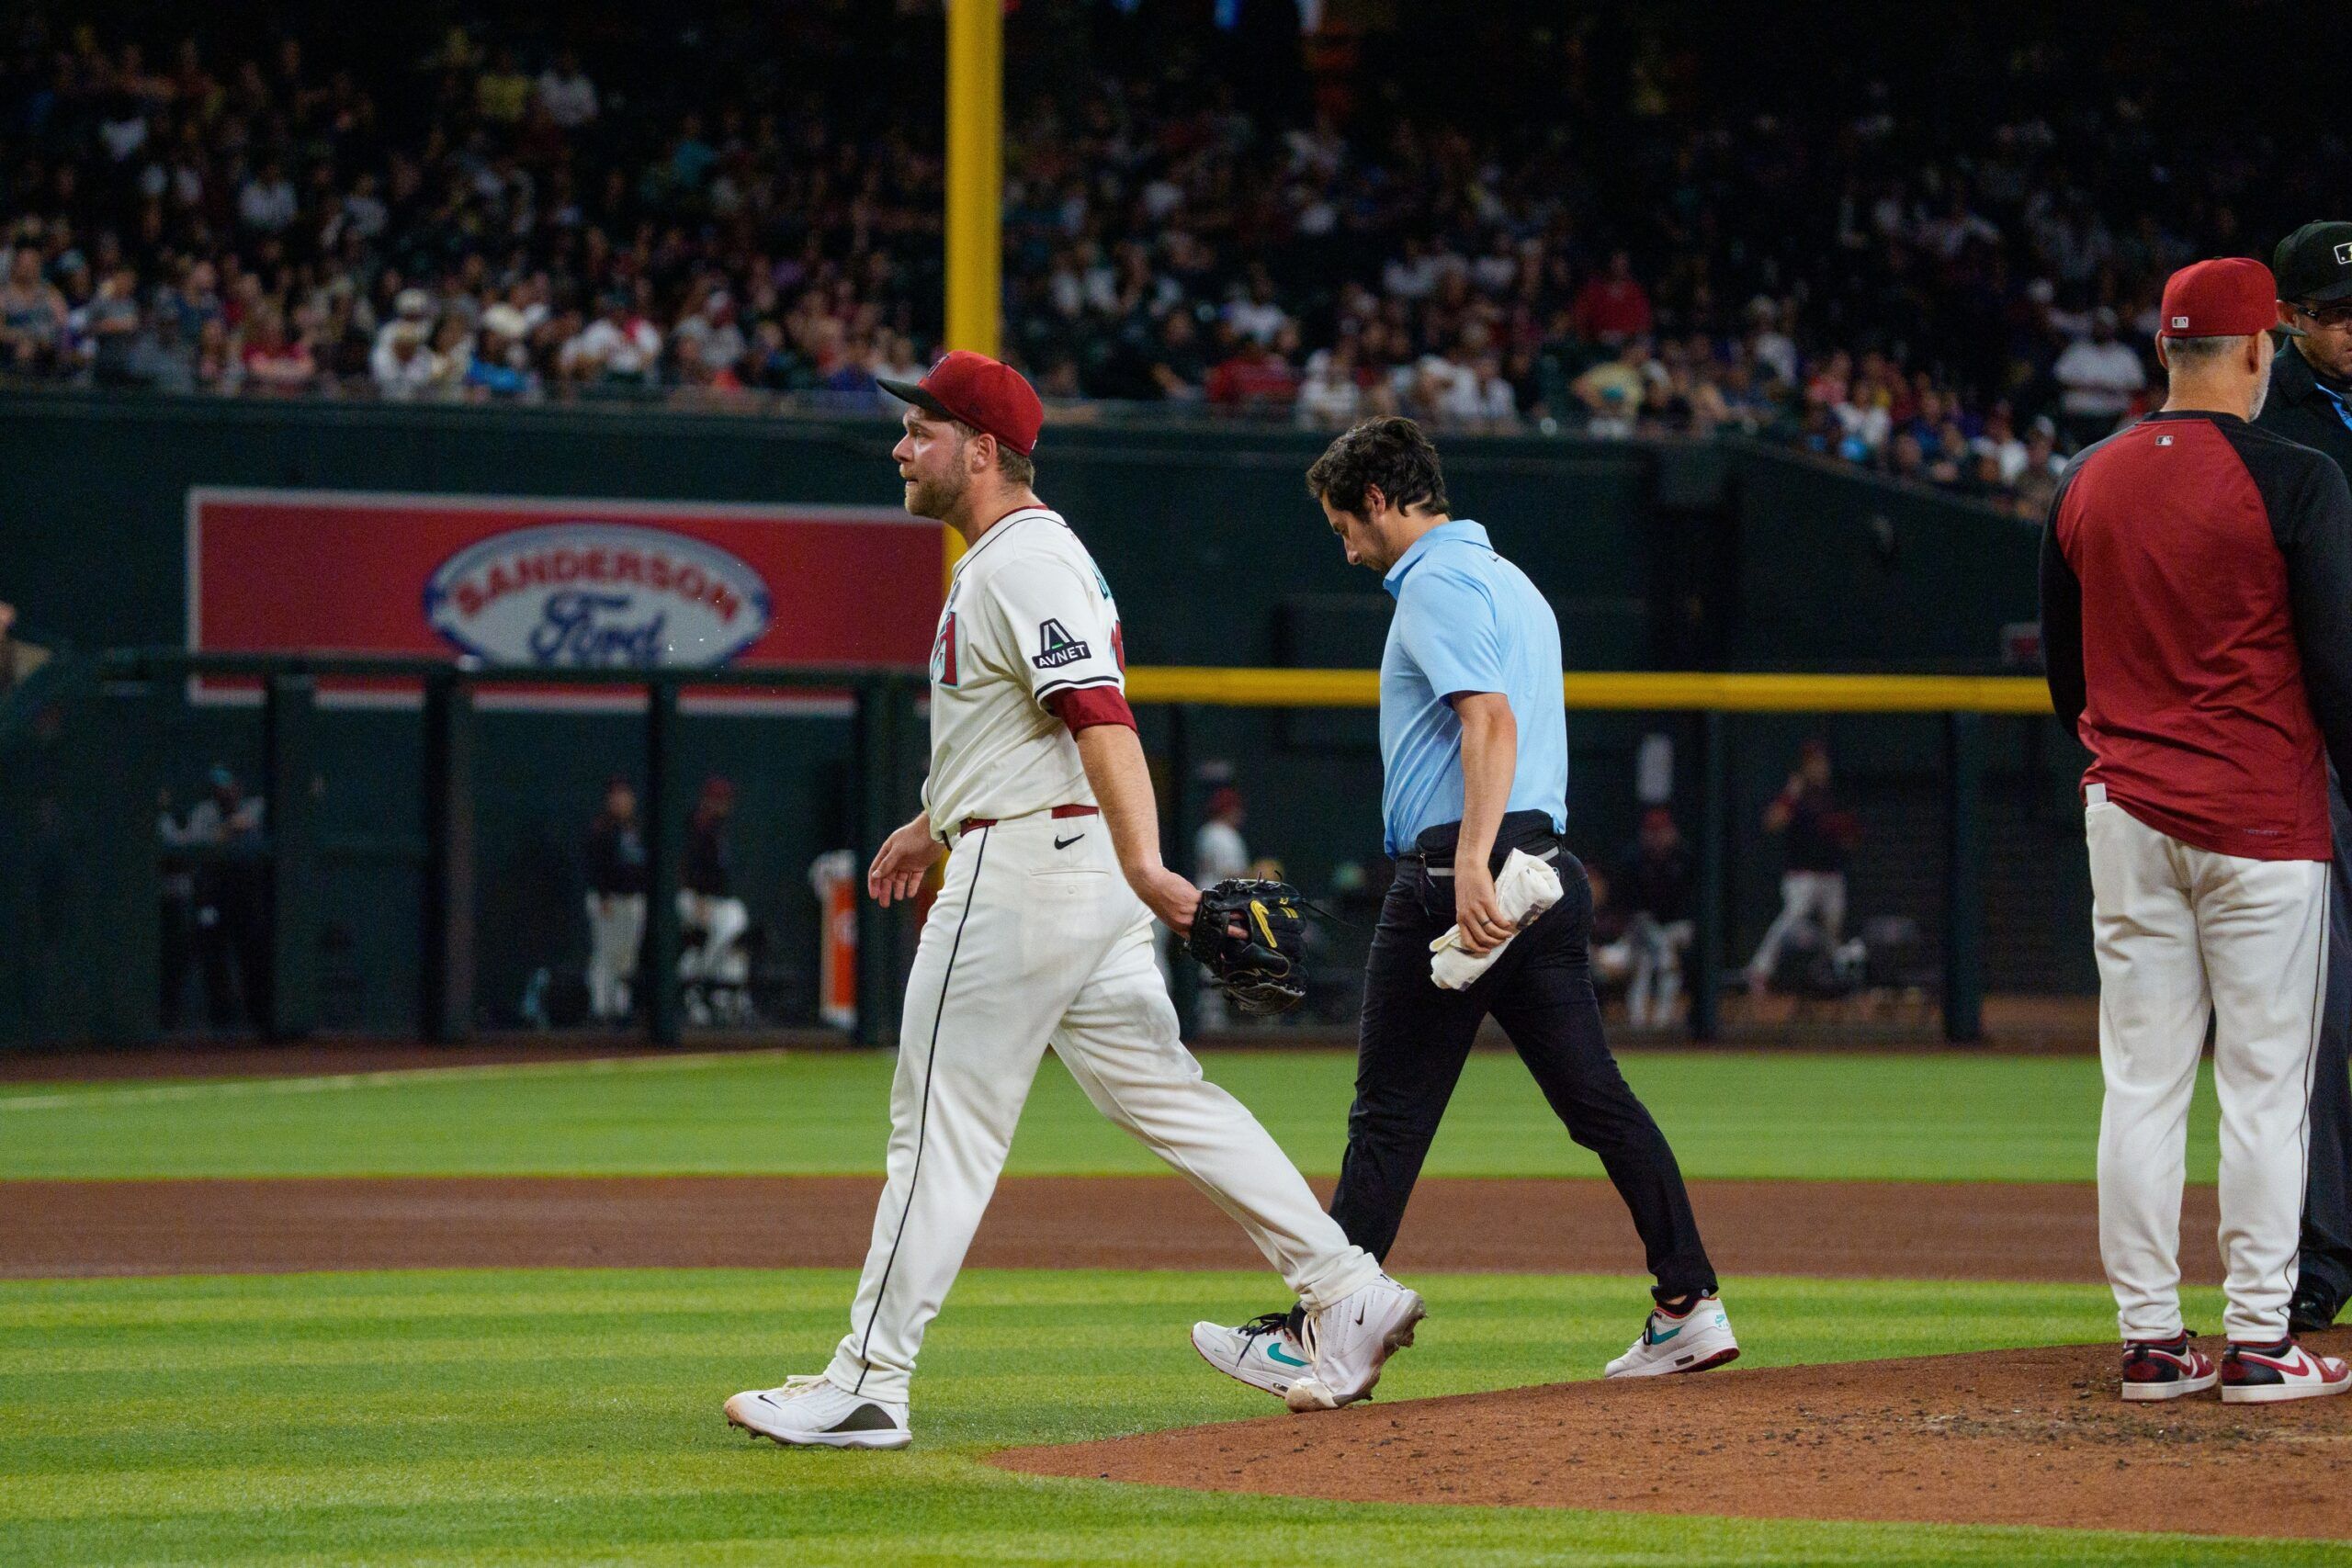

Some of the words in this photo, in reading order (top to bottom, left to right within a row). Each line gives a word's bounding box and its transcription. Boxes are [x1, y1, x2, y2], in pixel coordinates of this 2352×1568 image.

[457, 549, 741, 624] SANDERSON
[529, 592, 668, 667] Ford
[1038, 645, 1086, 667] AVNET
